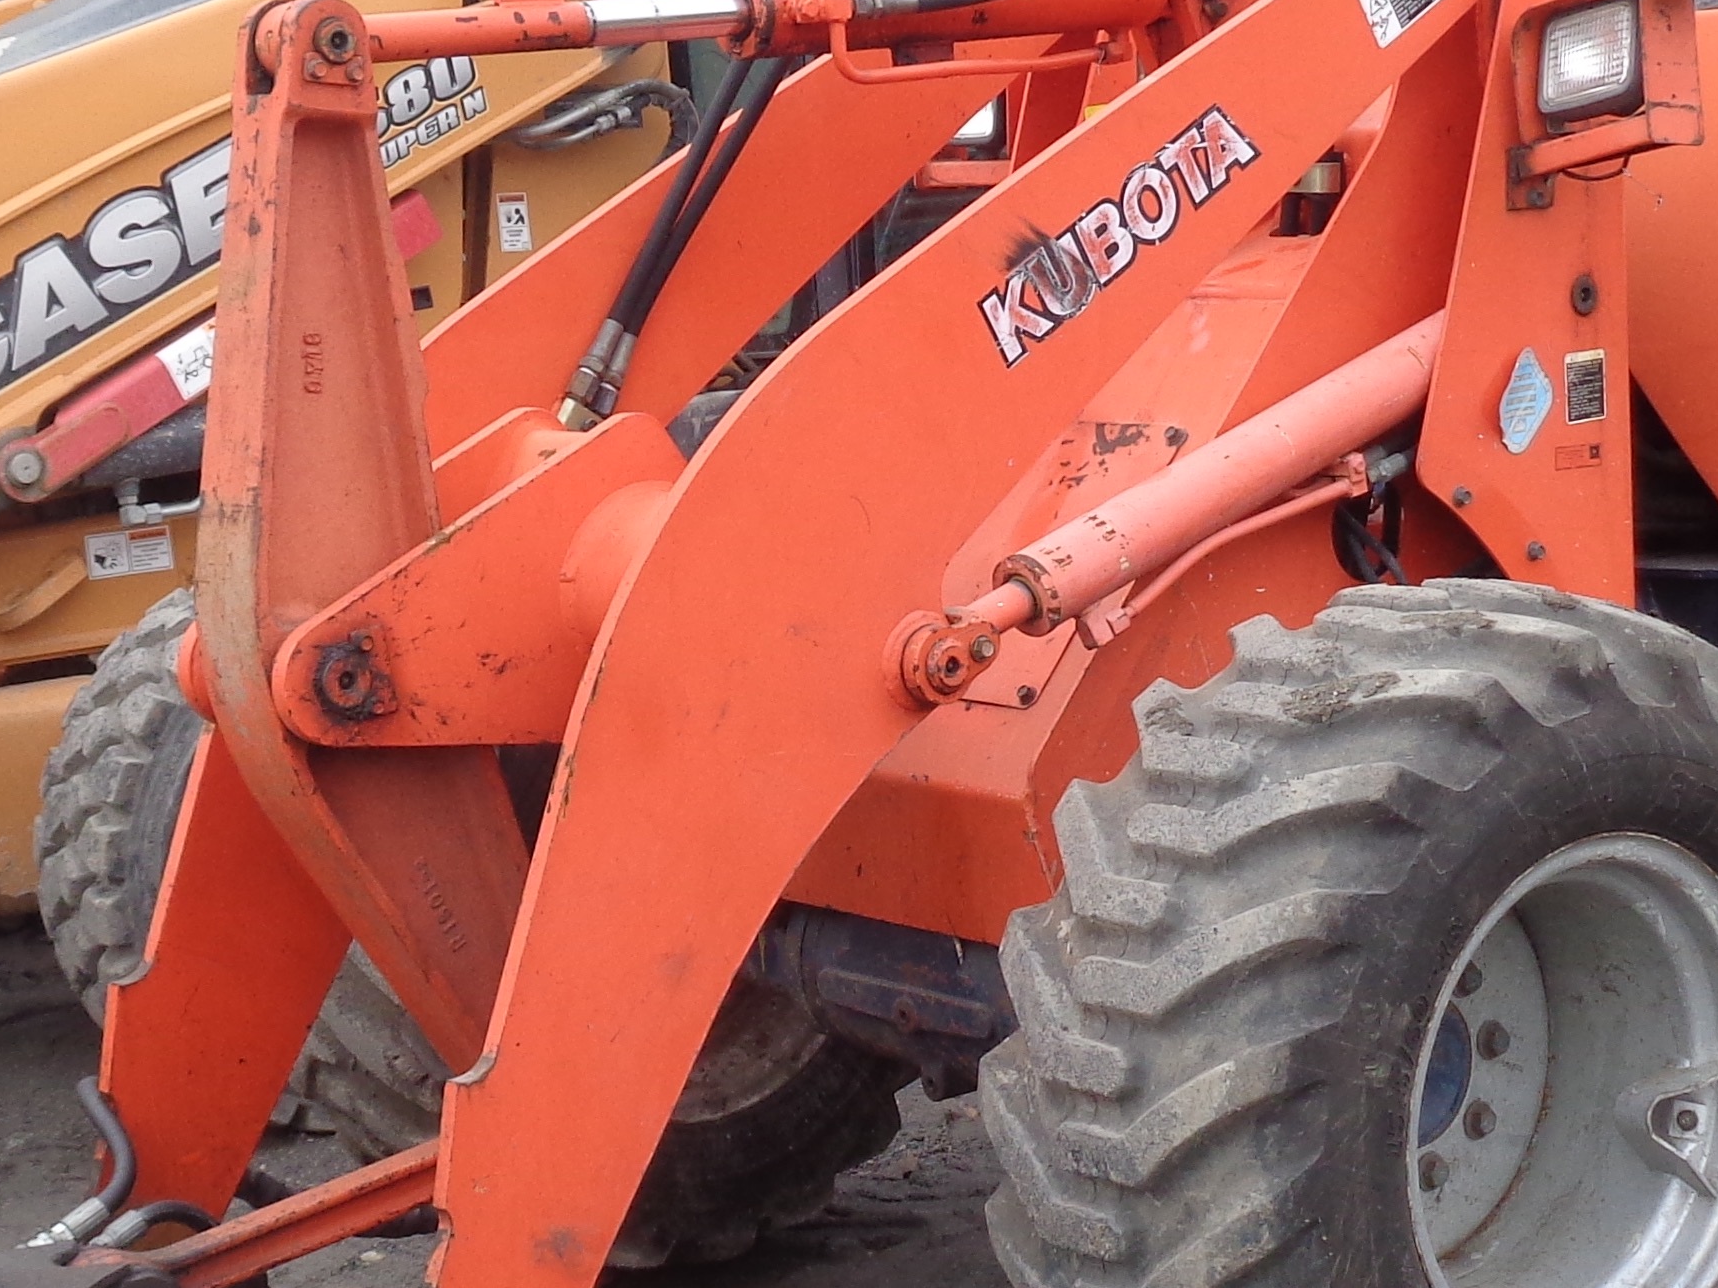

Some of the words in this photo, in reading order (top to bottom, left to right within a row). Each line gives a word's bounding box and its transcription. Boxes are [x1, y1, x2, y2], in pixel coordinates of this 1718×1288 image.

[377, 55, 477, 138] 80
[379, 104, 460, 169] UPER
[461, 86, 488, 121] N
[978, 104, 1261, 368] KUBOTA
